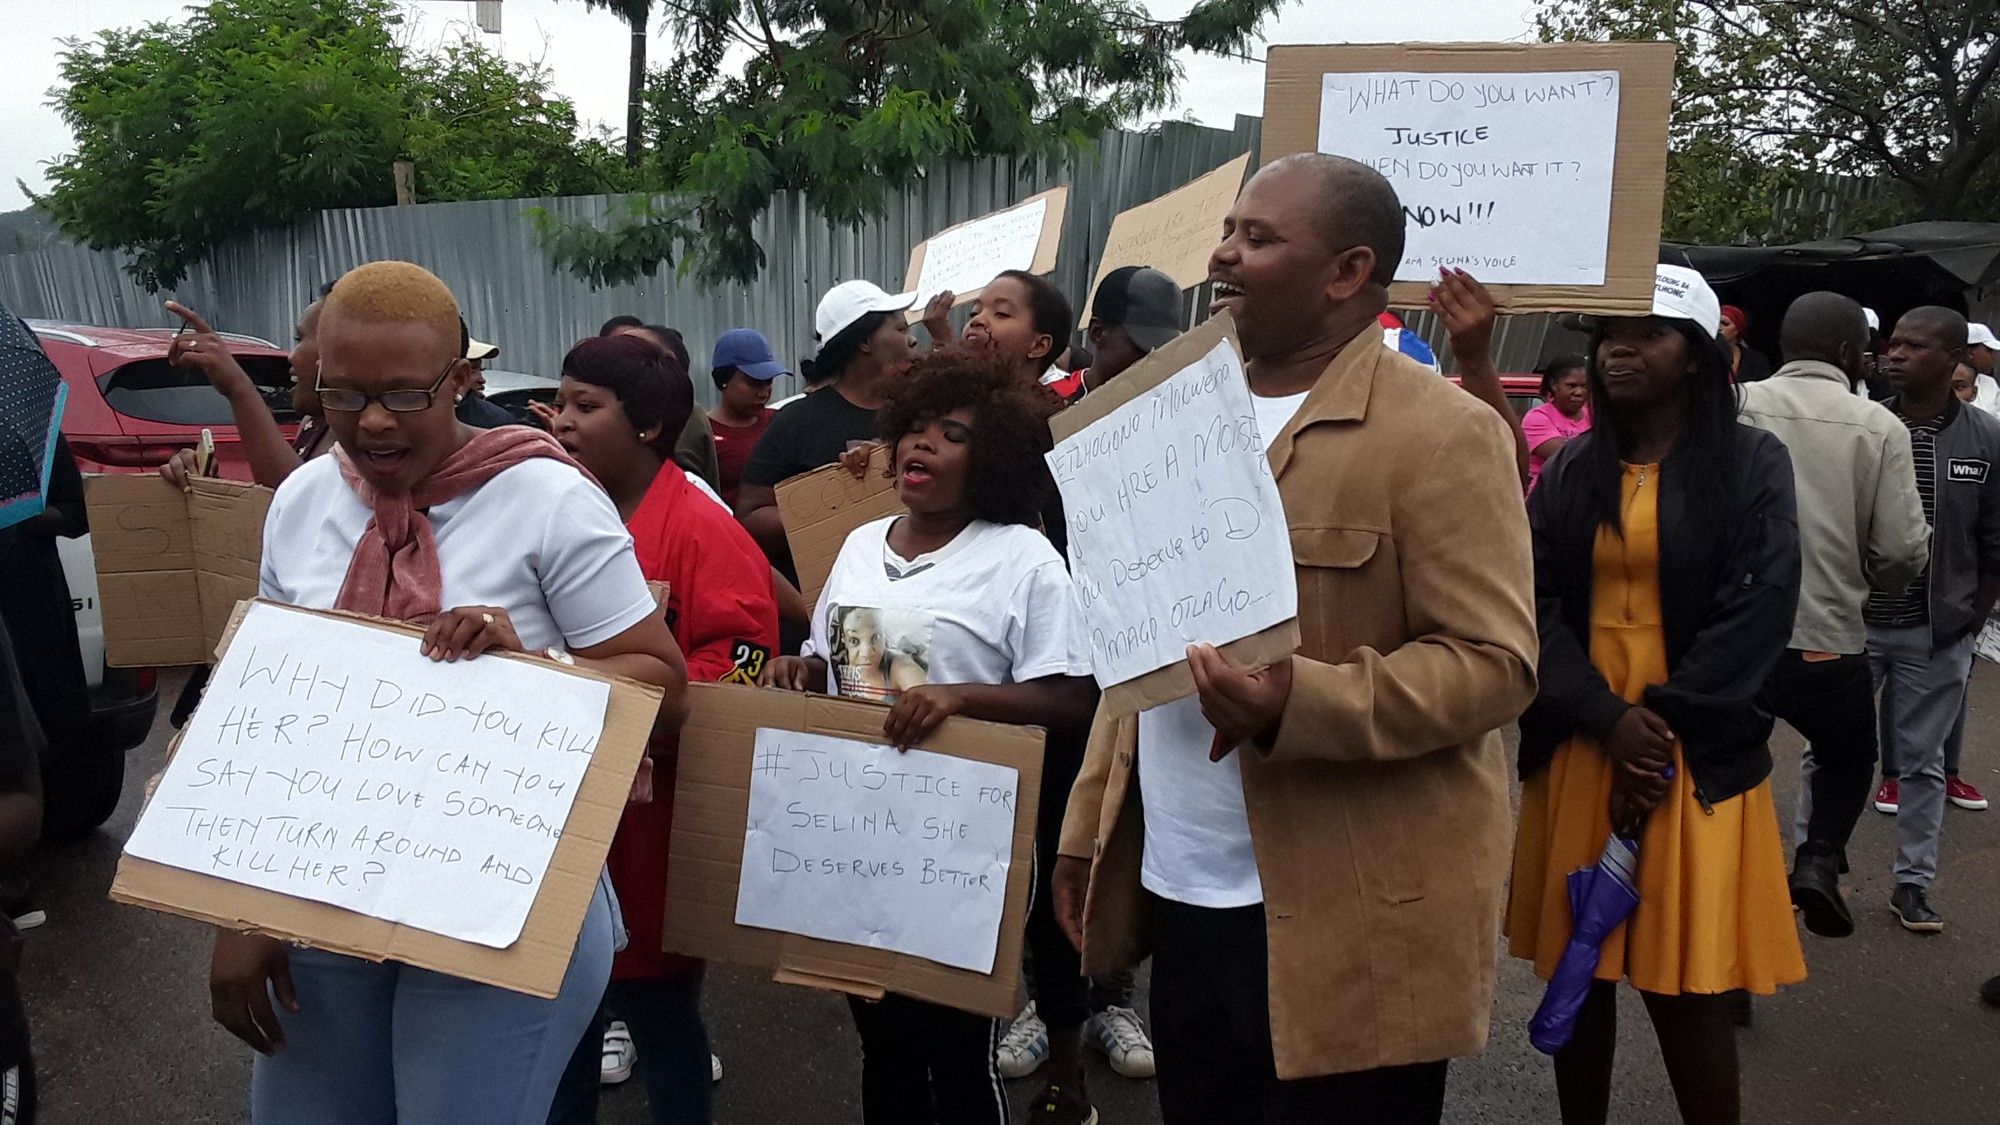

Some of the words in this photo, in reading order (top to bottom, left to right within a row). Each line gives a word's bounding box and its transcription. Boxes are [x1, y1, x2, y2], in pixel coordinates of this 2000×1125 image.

[1349, 78, 1421, 115] WHAT
[1428, 80, 1464, 103] DO
[1384, 125, 1489, 147] JUSTICE
[1418, 161, 1448, 180] DO
[1117, 461, 1159, 513] ARE
[1165, 444, 1180, 480] A
[1191, 524, 1210, 551] to
[734, 644, 765, 677] 23
[239, 645, 350, 713] WHY
[370, 678, 446, 717] DID
[453, 700, 523, 743] YOU
[536, 720, 595, 755] KILL
[217, 705, 330, 747] HER?
[340, 722, 424, 763] HOW
[436, 752, 492, 784] CAN
[502, 767, 566, 798] YOU
[187, 758, 258, 796] SAY
[265, 767, 342, 801] YOU
[355, 778, 426, 808] LOVE
[978, 786, 1014, 814] FOR
[785, 801, 901, 836] SELINA
[921, 816, 969, 840] SHE
[165, 806, 263, 845] THEN
[266, 815, 338, 850] TURN
[351, 825, 462, 864] AROUND
[479, 854, 534, 885] AND
[212, 844, 279, 873] KILL
[771, 847, 905, 879] DESERVES
[919, 857, 992, 893] BETTER
